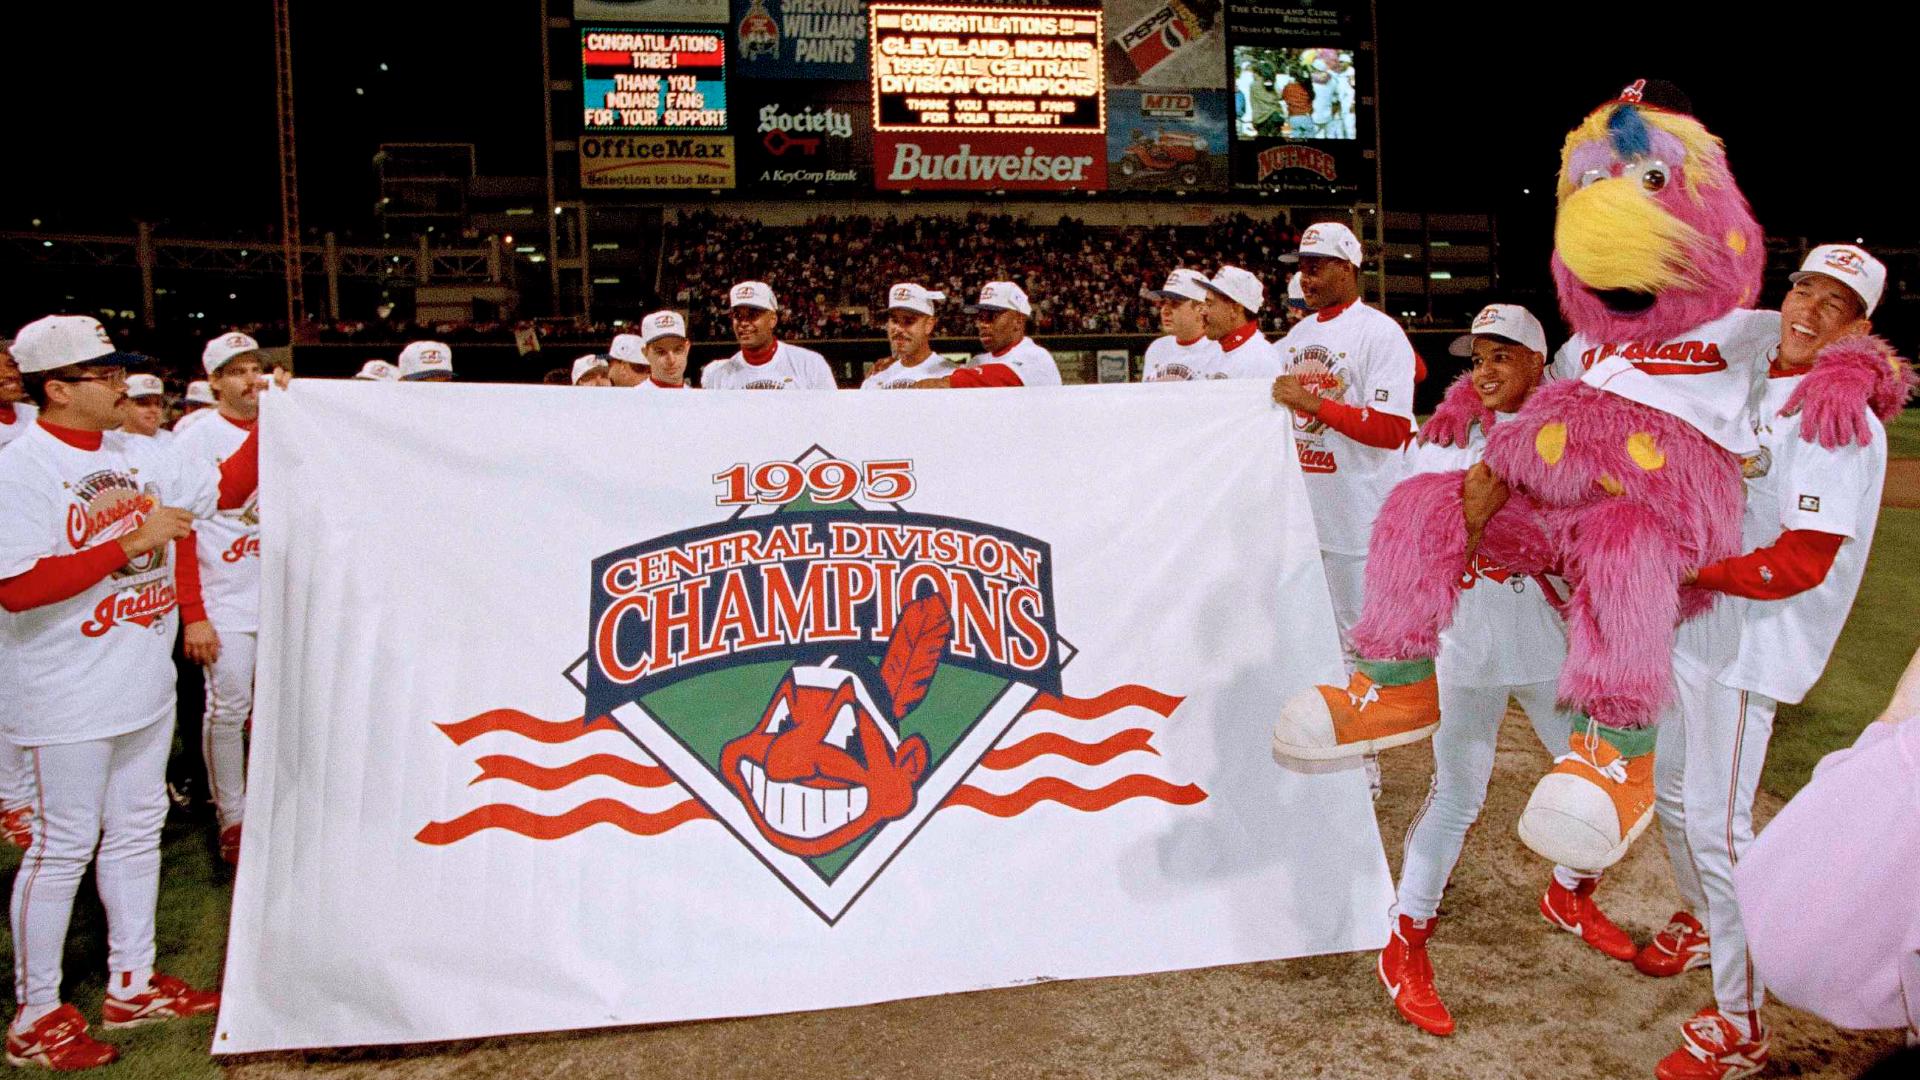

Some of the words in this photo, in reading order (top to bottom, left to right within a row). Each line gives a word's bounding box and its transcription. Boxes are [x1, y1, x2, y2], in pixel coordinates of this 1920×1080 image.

[783, 14, 867, 39] WILLIAMS
[901, 13, 1058, 35] CONGRATULATIONS
[1123, 6, 1174, 46] PEPSI
[587, 33, 718, 52] CONGRATULATIONS
[795, 39, 855, 63] PAINTS
[882, 37, 1010, 57] CLEVELAND
[1015, 39, 1093, 60] INDIANS
[631, 52, 678, 69] TRIBE!
[990, 59, 1086, 78] CENTRAL
[614, 74, 661, 91] THANK
[668, 74, 696, 92] YOU
[881, 75, 970, 94] DIVISION
[976, 77, 1097, 96] CHAMPIONS
[606, 92, 660, 109] INDIANS
[666, 92, 704, 109] FANS
[906, 98, 949, 110] THANK
[955, 99, 982, 111] YOU
[987, 100, 1036, 112] INDIANS
[1040, 101, 1076, 113] FANS
[1145, 95, 1192, 108] MTD
[584, 109, 614, 126] FOR
[620, 109, 659, 126] YOUR
[757, 103, 853, 138] Society
[921, 112, 949, 124] FOR
[954, 112, 990, 124] YOUR
[582, 138, 725, 158] OfficeMax
[888, 142, 1094, 182] Budweiser
[586, 172, 650, 185] Selection
[656, 174, 668, 185] to
[671, 174, 693, 185] the
[697, 174, 726, 185] Max
[760, 170, 771, 181] A
[773, 169, 824, 184] KeyCorp
[825, 169, 857, 181] Bank
[712, 458, 917, 507] 1995
[604, 522, 824, 599] CENTRAL
[831, 521, 1041, 590] DIVISION
